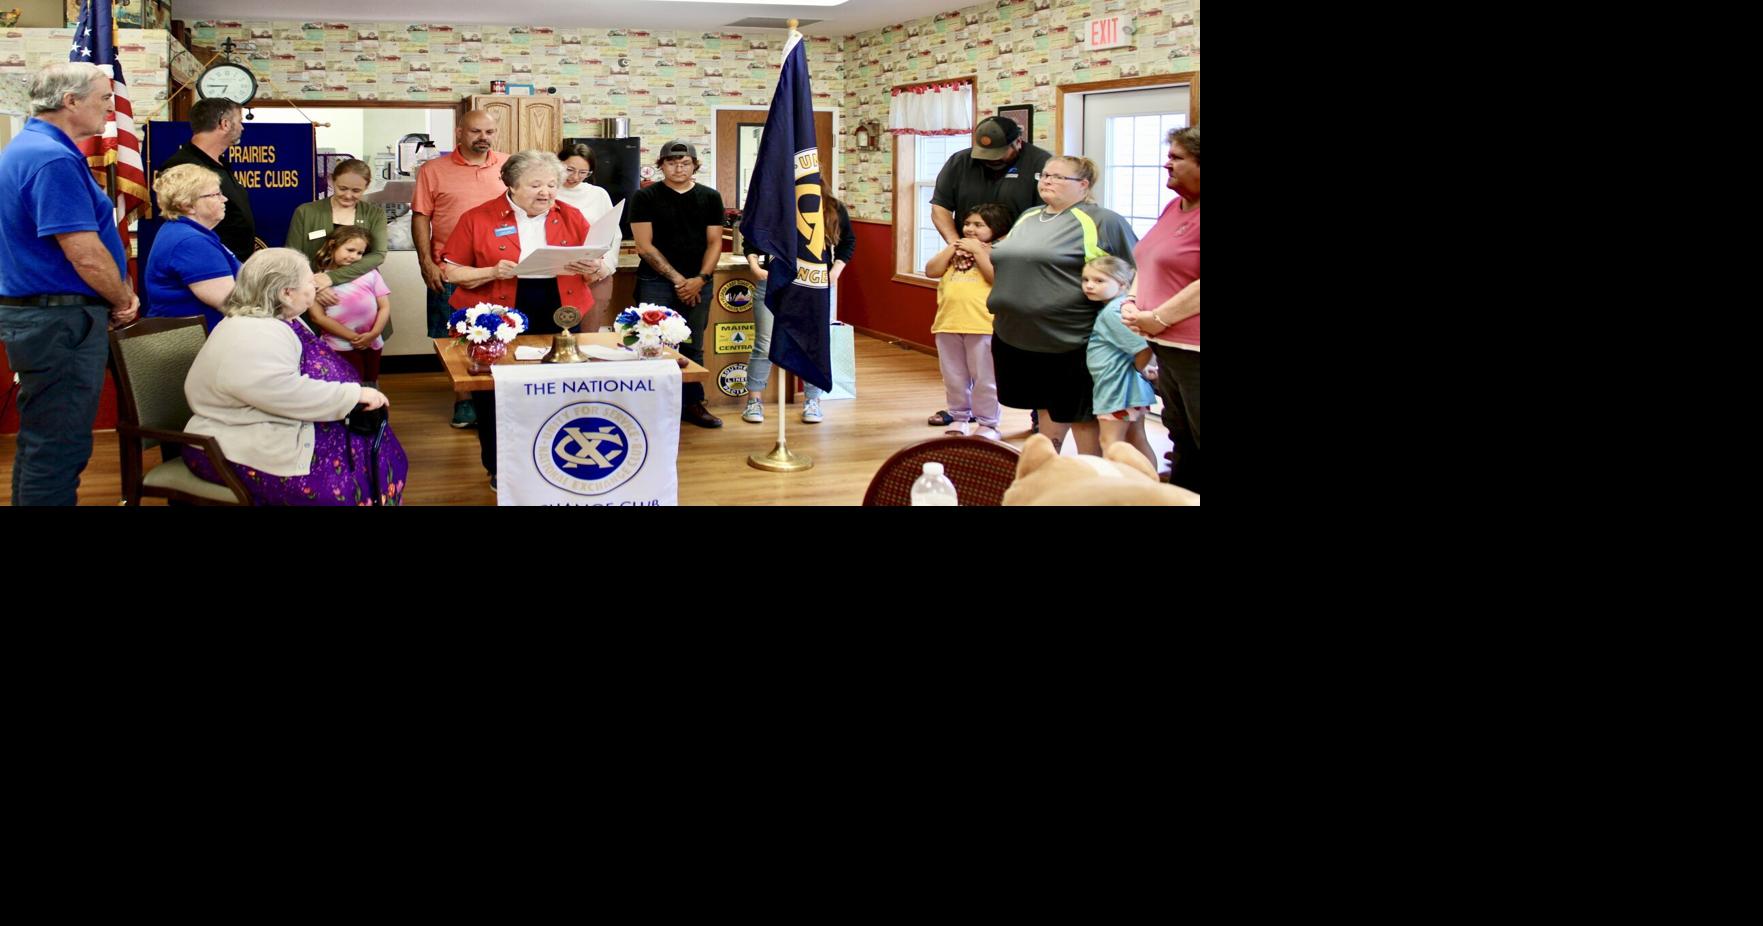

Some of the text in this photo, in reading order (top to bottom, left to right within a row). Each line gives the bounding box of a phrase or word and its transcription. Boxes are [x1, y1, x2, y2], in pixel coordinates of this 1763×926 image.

[1091, 16, 1118, 46] EXIT
[228, 145, 276, 163] PRAIRIES
[264, 170, 299, 188] CLUBS
[523, 379, 655, 395] THE NATIONAL
[574, 405, 600, 416] FOR
[602, 406, 640, 438] SERVICE
